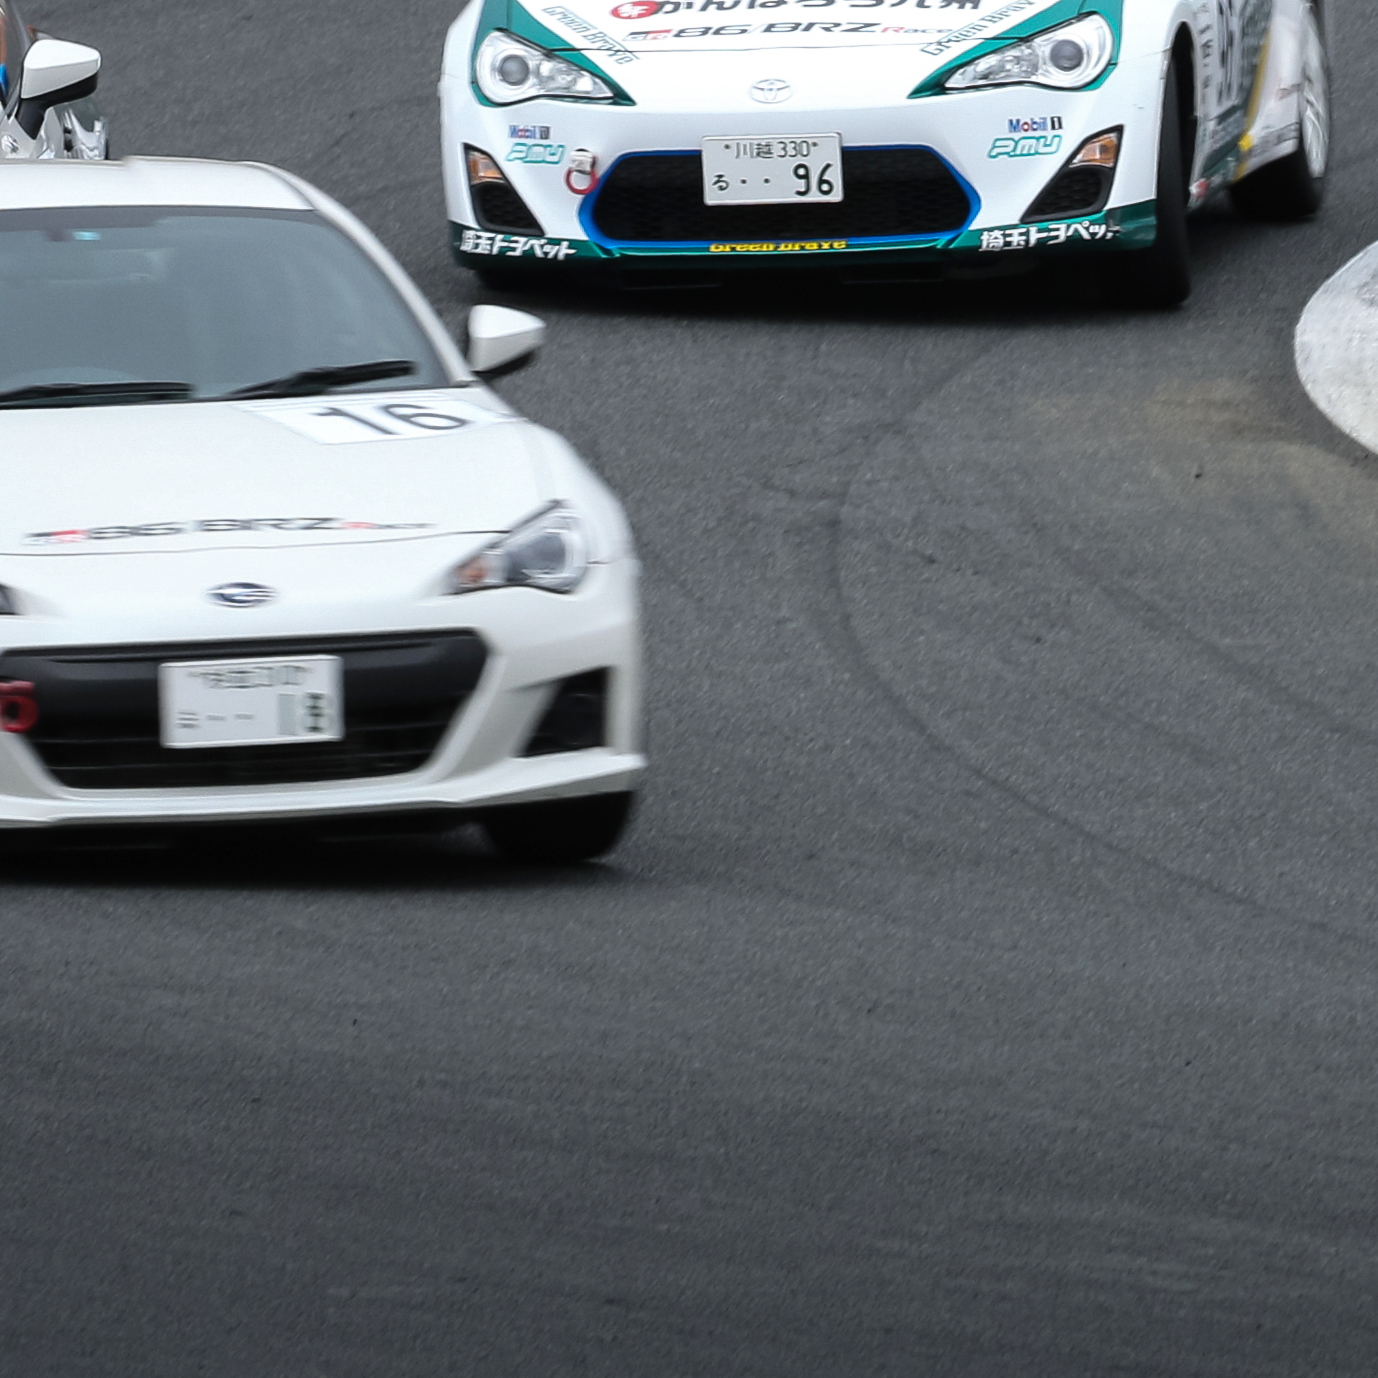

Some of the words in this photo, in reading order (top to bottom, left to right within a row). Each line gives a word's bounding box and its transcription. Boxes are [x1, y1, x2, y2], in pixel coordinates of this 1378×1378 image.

[1008, 118, 1048, 133] Mobil
[776, 141, 811, 157] 330
[712, 174, 729, 191] る
[793, 163, 834, 196] 96
[460, 229, 577, 261] 埼玉トヨペット
[310, 404, 470, 435] 16
